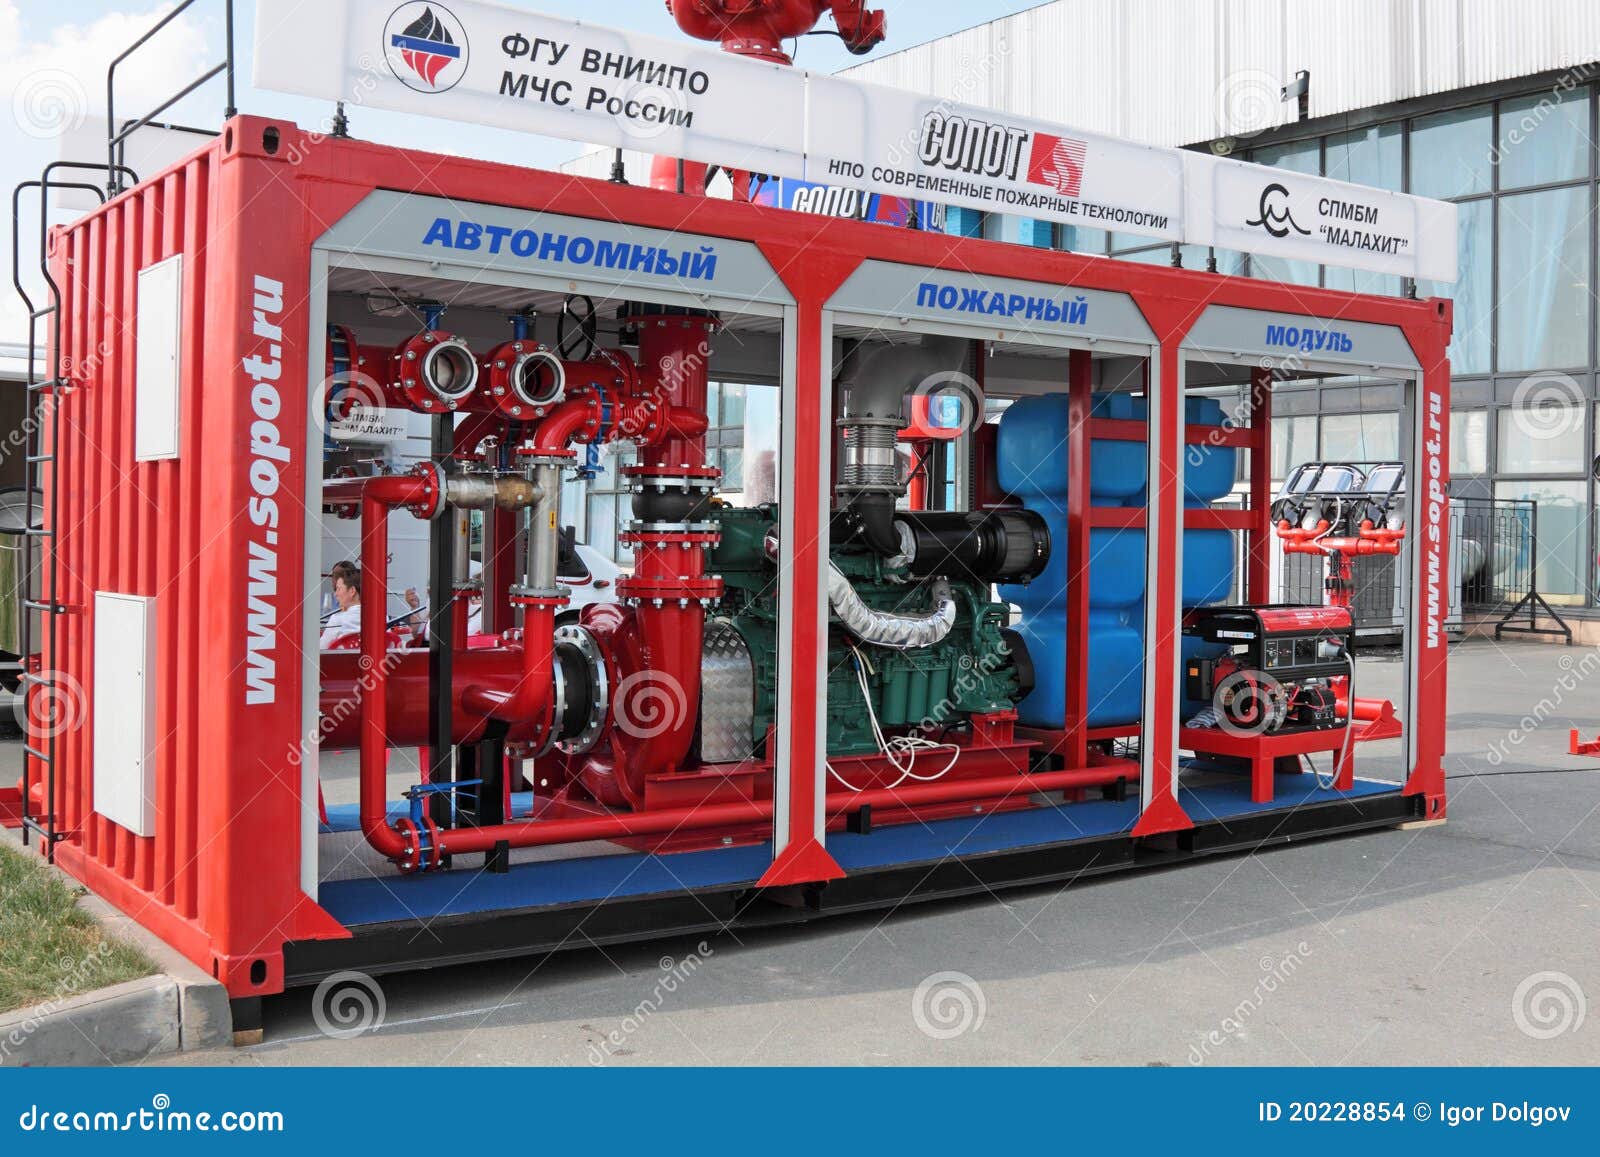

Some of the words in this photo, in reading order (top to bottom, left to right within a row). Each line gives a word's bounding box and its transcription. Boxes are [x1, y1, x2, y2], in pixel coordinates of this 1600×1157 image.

[499, 71, 573, 106] МЧС
[501, 33, 568, 65] ФГУ
[580, 48, 710, 95] ВНИИПО
[918, 111, 1029, 182] СОПОТ
[829, 159, 865, 179] НПО
[871, 167, 992, 200] СОВРЕМЕННЫЕ
[995, 188, 1079, 215] ПОЖАРНЫЕ
[1081, 203, 1169, 230] ТЕХНОЛОГИИ
[1319, 198, 1378, 225] СПМБМ
[422, 217, 717, 281] АВТОНОМНЫЙ
[916, 282, 1089, 325] ПОЖАРНЫЙ
[1265, 324, 1353, 353] МОДУЛЬ
[241, 274, 291, 705] www.sopot.ru
[1427, 392, 1446, 649] www.sopot.ru
